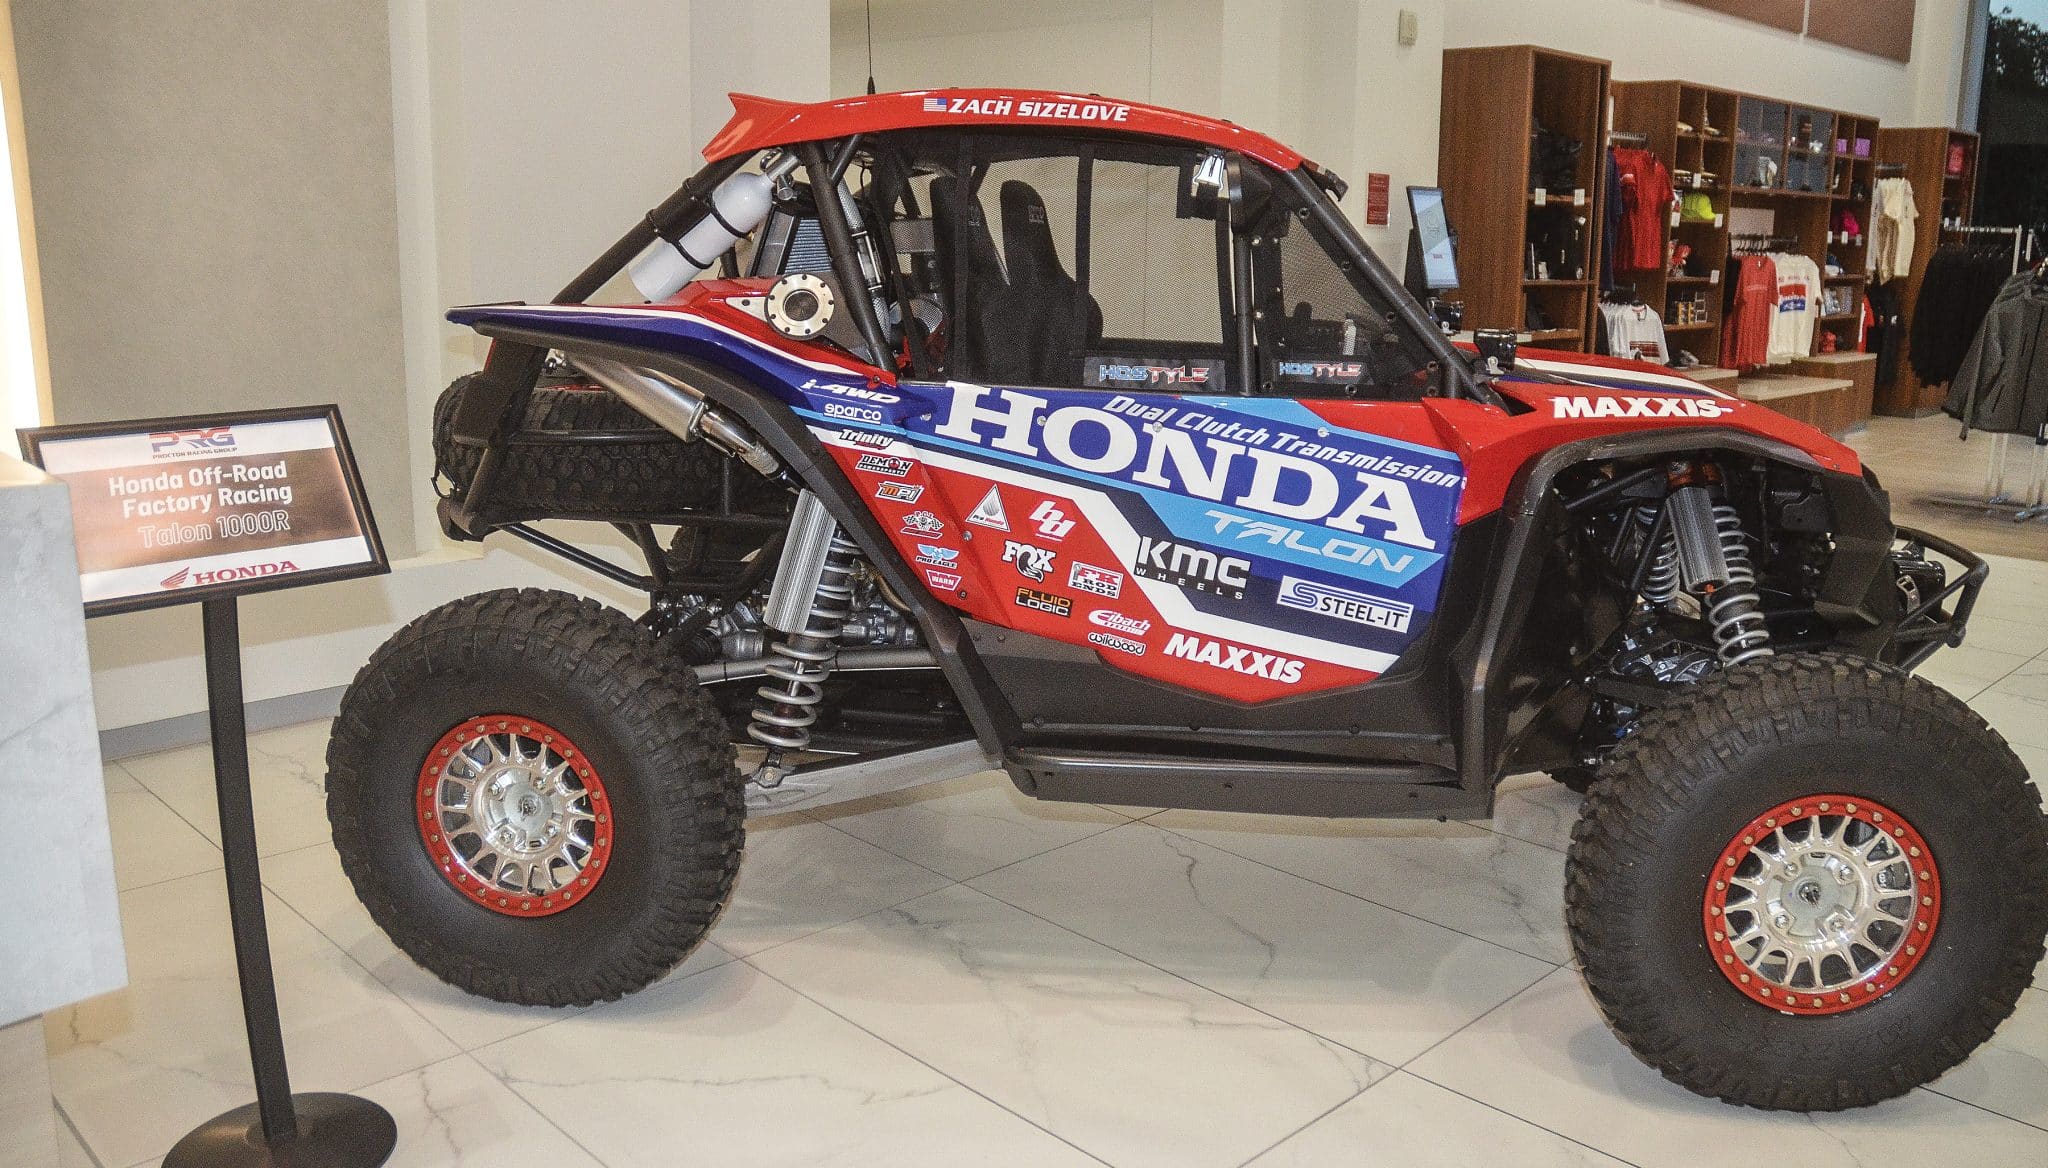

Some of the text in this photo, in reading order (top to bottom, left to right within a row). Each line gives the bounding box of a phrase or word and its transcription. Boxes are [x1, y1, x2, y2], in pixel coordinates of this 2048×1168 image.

[948, 98, 1131, 122] ZACH SIZELOVE
[824, 403, 882, 420] sparco
[1553, 396, 1723, 419] MAXXIS
[149, 427, 236, 452] PRG
[840, 429, 895, 447] Trinity
[1102, 395, 1461, 488] Dual Clutch Transmission
[861, 455, 912, 470] DEMON
[935, 381, 1436, 549] HONDA
[108, 460, 288, 497] Honda Off-Road
[122, 484, 293, 519] Factory Racing
[138, 509, 291, 549] Talon 1000R
[1205, 510, 1415, 573] TALON
[193, 561, 300, 585] HONDA
[916, 555, 957, 568] PRO EAGLE
[1001, 539, 1057, 583] FOX
[931, 575, 955, 586] WARN
[1078, 567, 1120, 586] FK
[1083, 578, 1117, 591] ROD
[1135, 567, 1244, 600] WHEELS
[1017, 587, 1071, 607] FLUID
[1072, 581, 1116, 597] ENDS
[1015, 596, 1070, 617] LOGIC
[1320, 597, 1405, 628] STEEL-IT
[1088, 609, 1151, 634] Eibach
[1089, 633, 1145, 655] wilwood
[1163, 633, 1306, 684] MAXXIS
